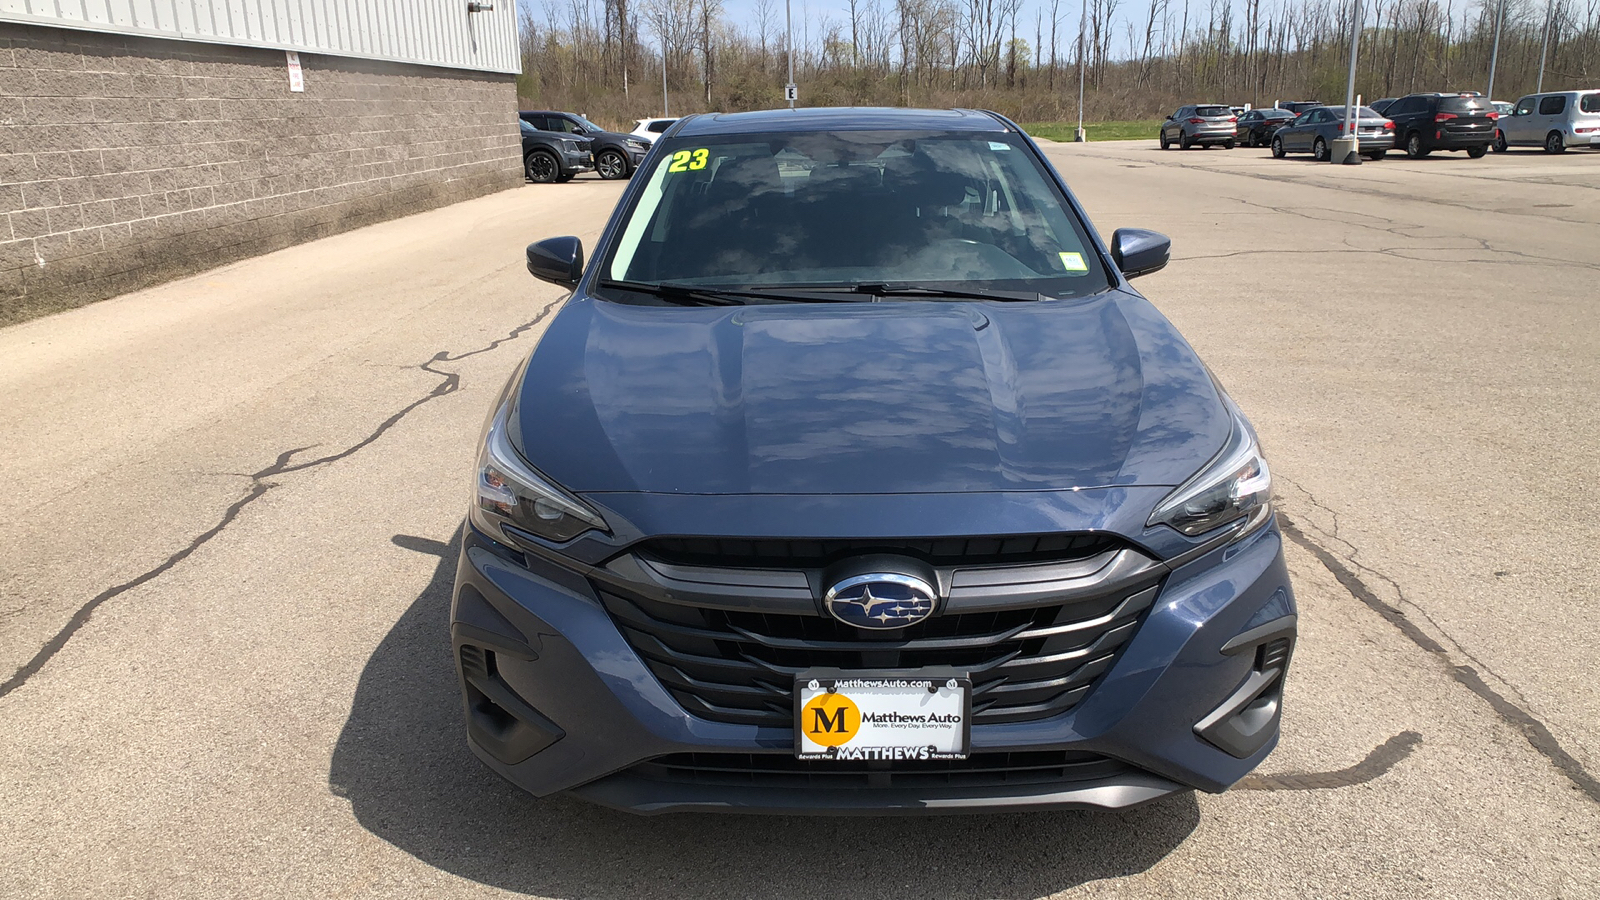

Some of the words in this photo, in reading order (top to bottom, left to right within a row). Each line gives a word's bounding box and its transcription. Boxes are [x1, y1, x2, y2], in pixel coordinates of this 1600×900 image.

[789, 88, 794, 98] E
[668, 148, 709, 172] 23
[833, 679, 932, 688] MatthewsAuto.com
[810, 707, 849, 733] M
[862, 711, 926, 723] Matthews
[927, 712, 961, 723] Auto
[836, 746, 929, 760] MATTHEWS
